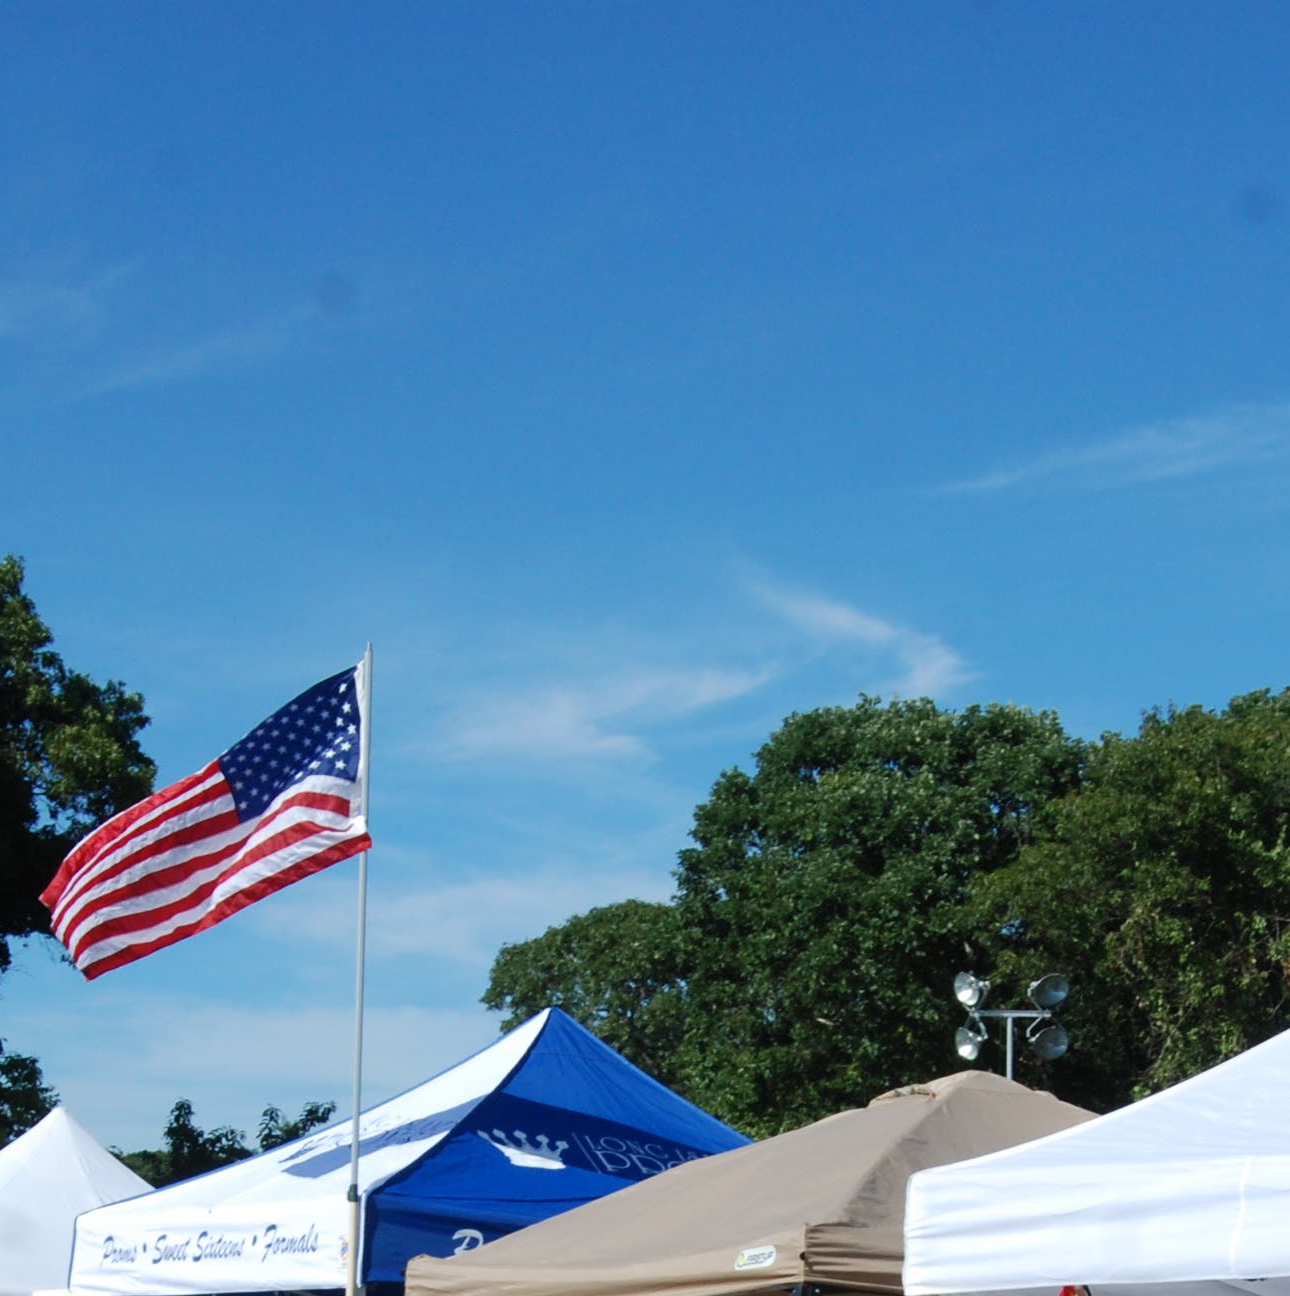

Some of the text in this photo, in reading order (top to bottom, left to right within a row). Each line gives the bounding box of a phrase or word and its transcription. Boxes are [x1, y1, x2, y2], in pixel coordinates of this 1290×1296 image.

[100, 1235, 138, 1268] Proms
[152, 1234, 189, 1265] Sweet
[193, 1230, 246, 1263] Sixteens
[262, 1224, 319, 1263] Formals
